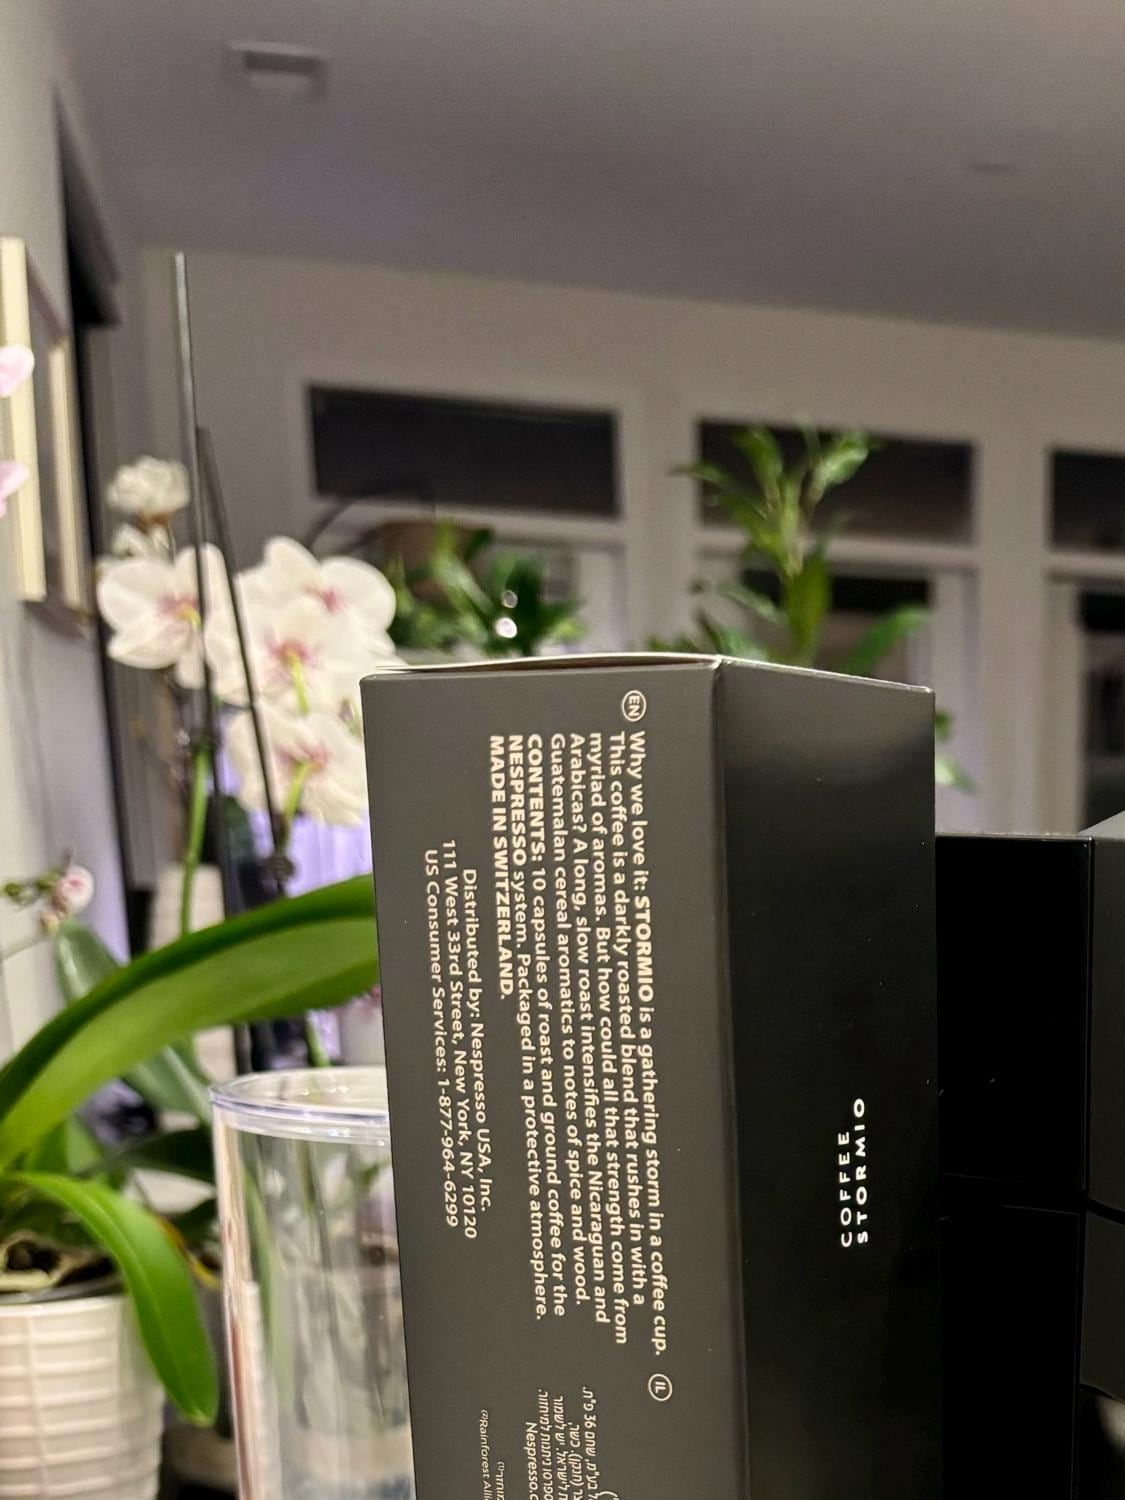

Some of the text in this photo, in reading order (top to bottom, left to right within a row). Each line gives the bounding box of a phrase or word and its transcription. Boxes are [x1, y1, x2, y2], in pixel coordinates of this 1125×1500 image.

[425, 850, 458, 1226] US Consumer Services: 1-877-964-6299
[443, 840, 477, 1238] 111 West 33rd Street, New York, NY 10120
[463, 869, 492, 1211] Distributed by: Nespresso USA, Inc.
[490, 736, 513, 998] MADE IN SWITZERLAND.
[509, 735, 548, 1319] NESPRESSO system. Packaged in a protective atmosphere.
[528, 734, 568, 1316] CONTENTS: 10 capsules of roast and ground coffee for the
[551, 734, 590, 1304] Guatemalan cereal aromatics to notes of spice and wood.
[570, 734, 610, 1323] Arabicas? A long, slow roast intensifies the Nicaraguan and
[583, 733, 629, 1344] myriad of aromas. But how could all that strength come from
[610, 731, 647, 1305] This coffee is a darkly roasted blend that rushes in with a
[622, 731, 668, 1355] Why we love it: STORMIO is a gathering storm in a coffee cup.
[837, 1131, 853, 1248] COFFEE
[853, 1098, 869, 1244] STORMIO
